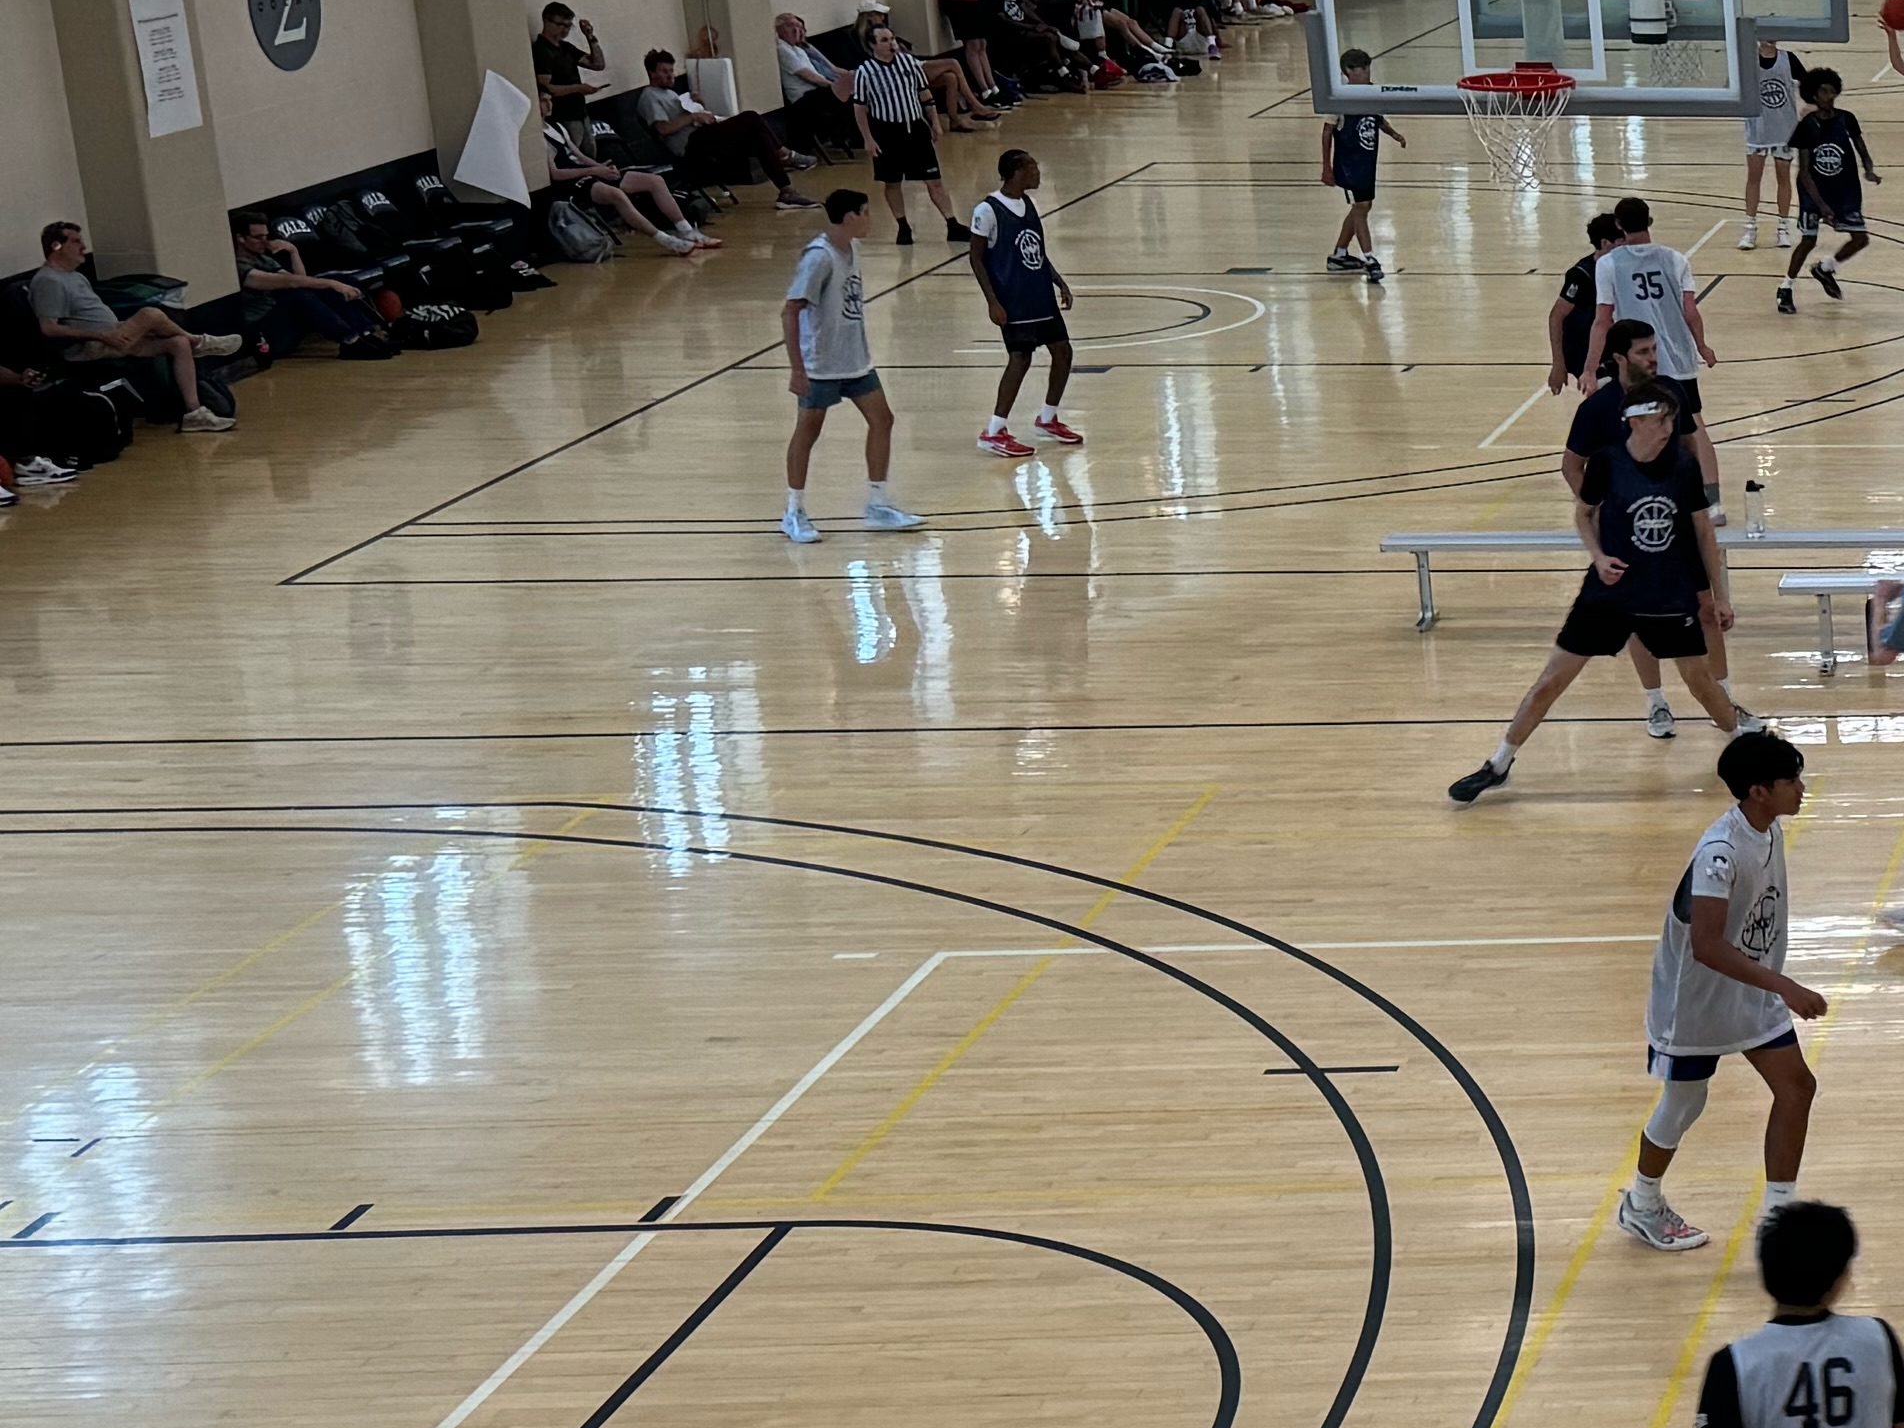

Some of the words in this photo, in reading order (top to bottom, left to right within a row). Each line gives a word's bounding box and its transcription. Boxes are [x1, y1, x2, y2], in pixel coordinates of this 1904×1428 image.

[591, 121, 616, 136] ALE
[362, 191, 391, 210] YALE
[277, 219, 313, 238] YALE
[1632, 271, 1665, 301] 35
